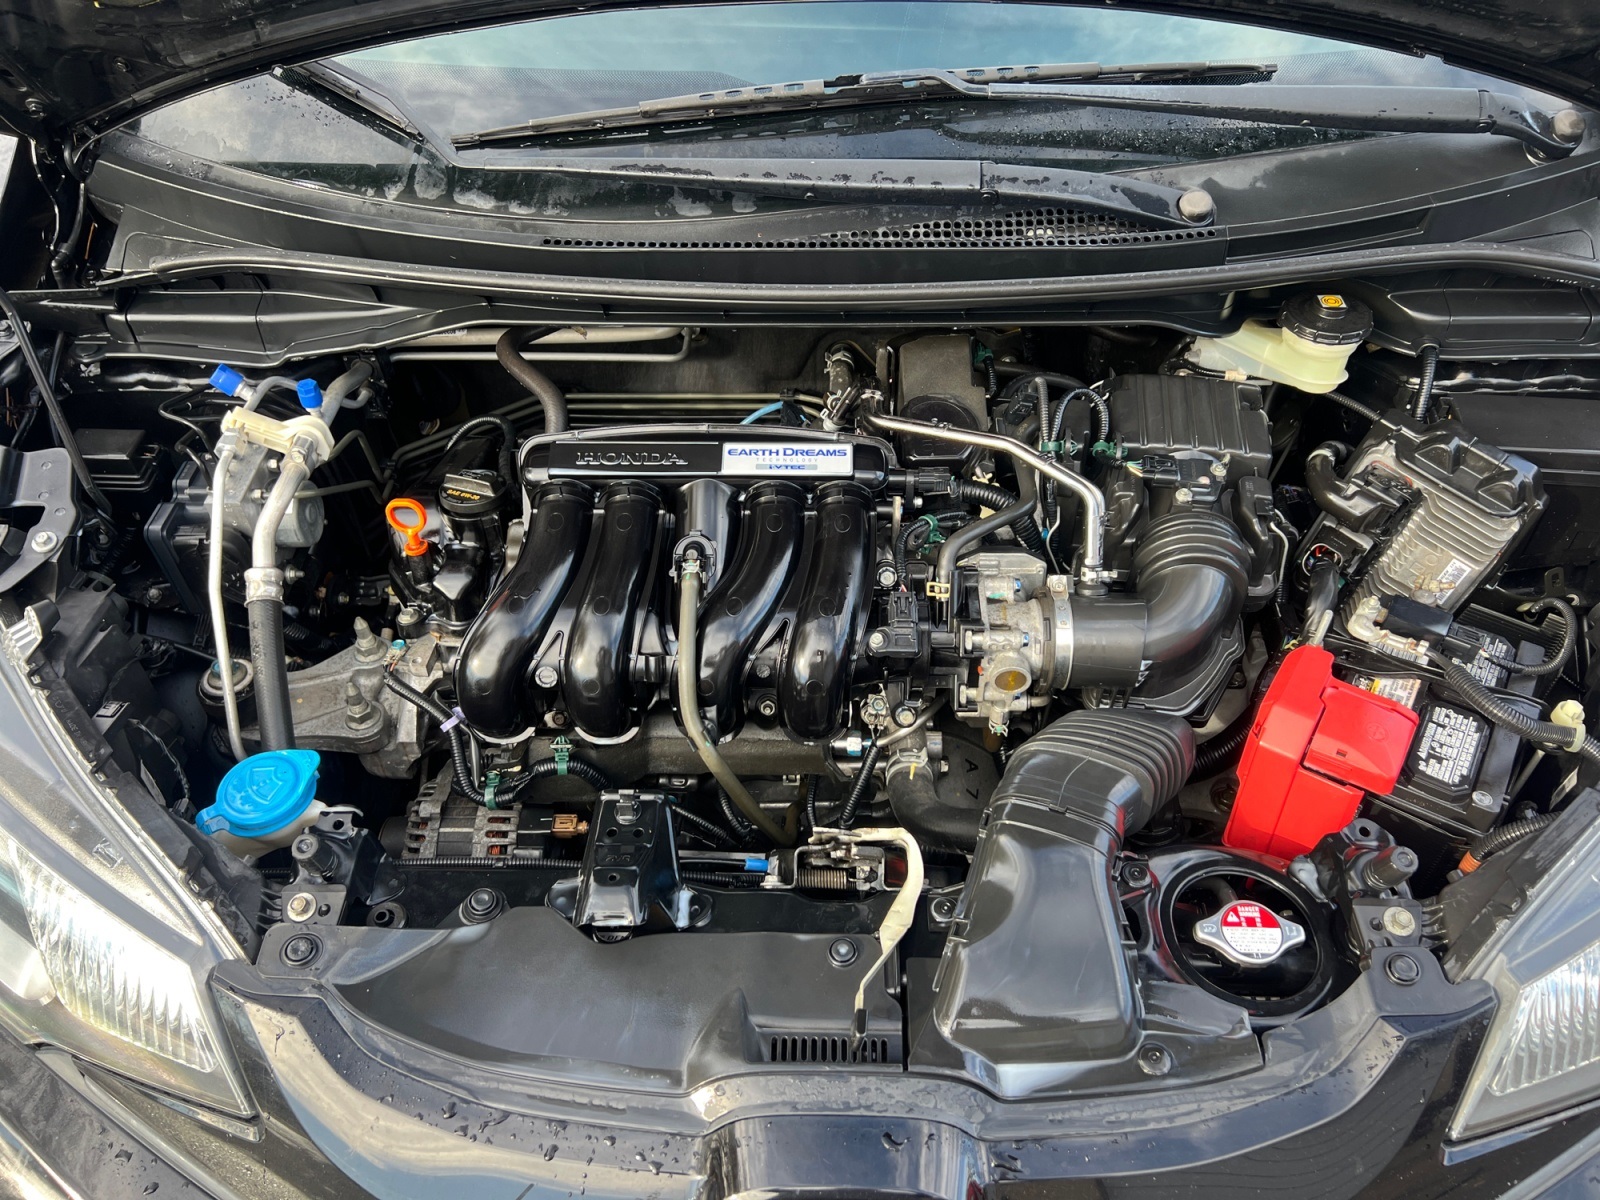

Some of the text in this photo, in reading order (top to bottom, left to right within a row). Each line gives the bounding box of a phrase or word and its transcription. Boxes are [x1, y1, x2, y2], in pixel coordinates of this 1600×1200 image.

[727, 447, 848, 457] EARTH DREAMS
[575, 452, 689, 465] HONDA
